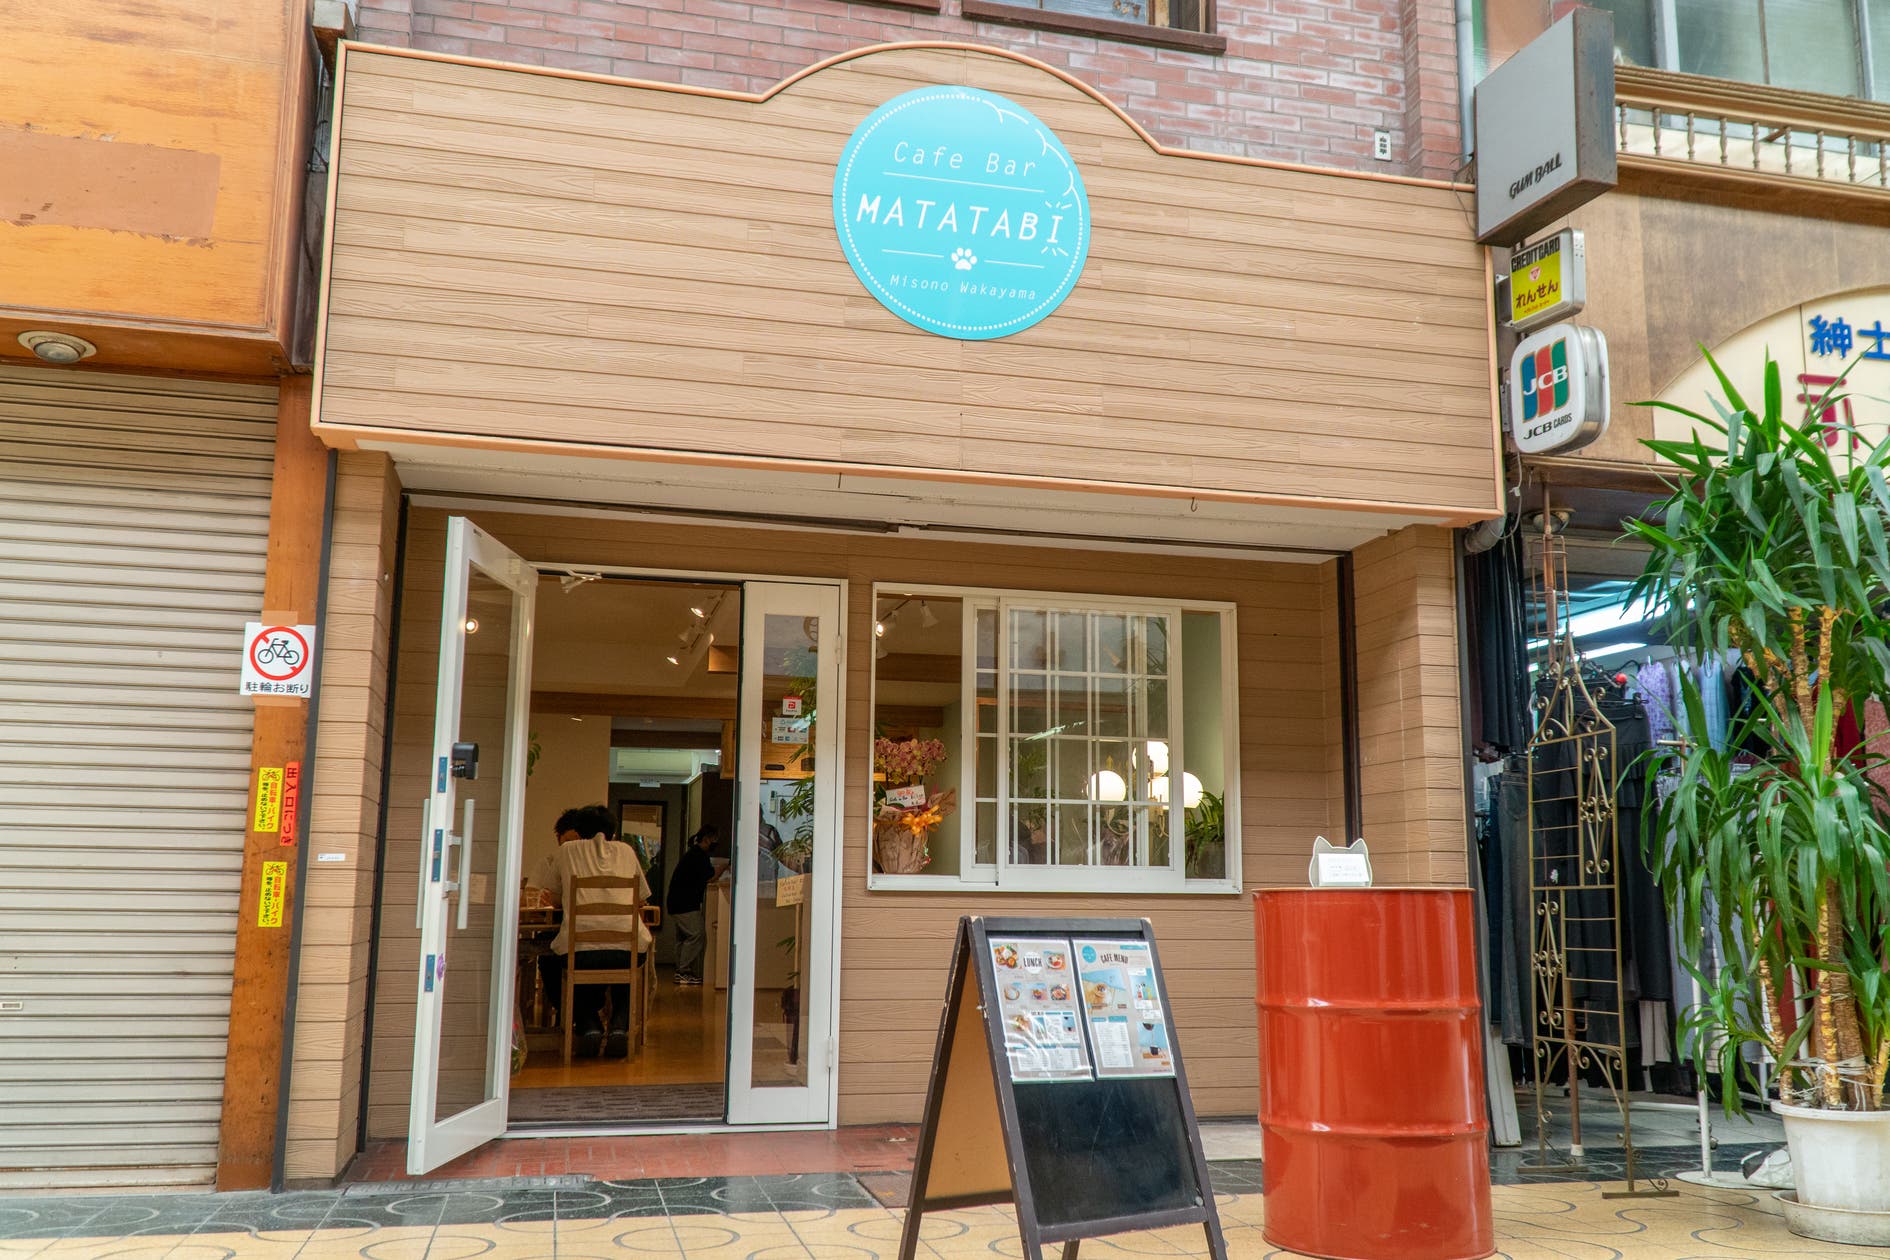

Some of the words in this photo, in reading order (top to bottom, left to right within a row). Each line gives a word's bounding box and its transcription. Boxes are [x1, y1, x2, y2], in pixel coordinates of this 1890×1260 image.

[894, 141, 964, 169] Cafe
[985, 152, 1036, 177] Bar
[1509, 170, 1534, 200] GUM
[1534, 151, 1563, 184] BALL
[856, 193, 1064, 244] MATATABI
[889, 274, 949, 292] Misono
[959, 280, 1036, 300] Wakayama
[1515, 279, 1559, 309] れんせん
[1523, 364, 1568, 396] JCB
[1523, 421, 1553, 440] JCB
[1553, 412, 1573, 429] CARDS
[245, 681, 309, 694] 駐輪お断り
[1023, 957, 1042, 968] LUNCH
